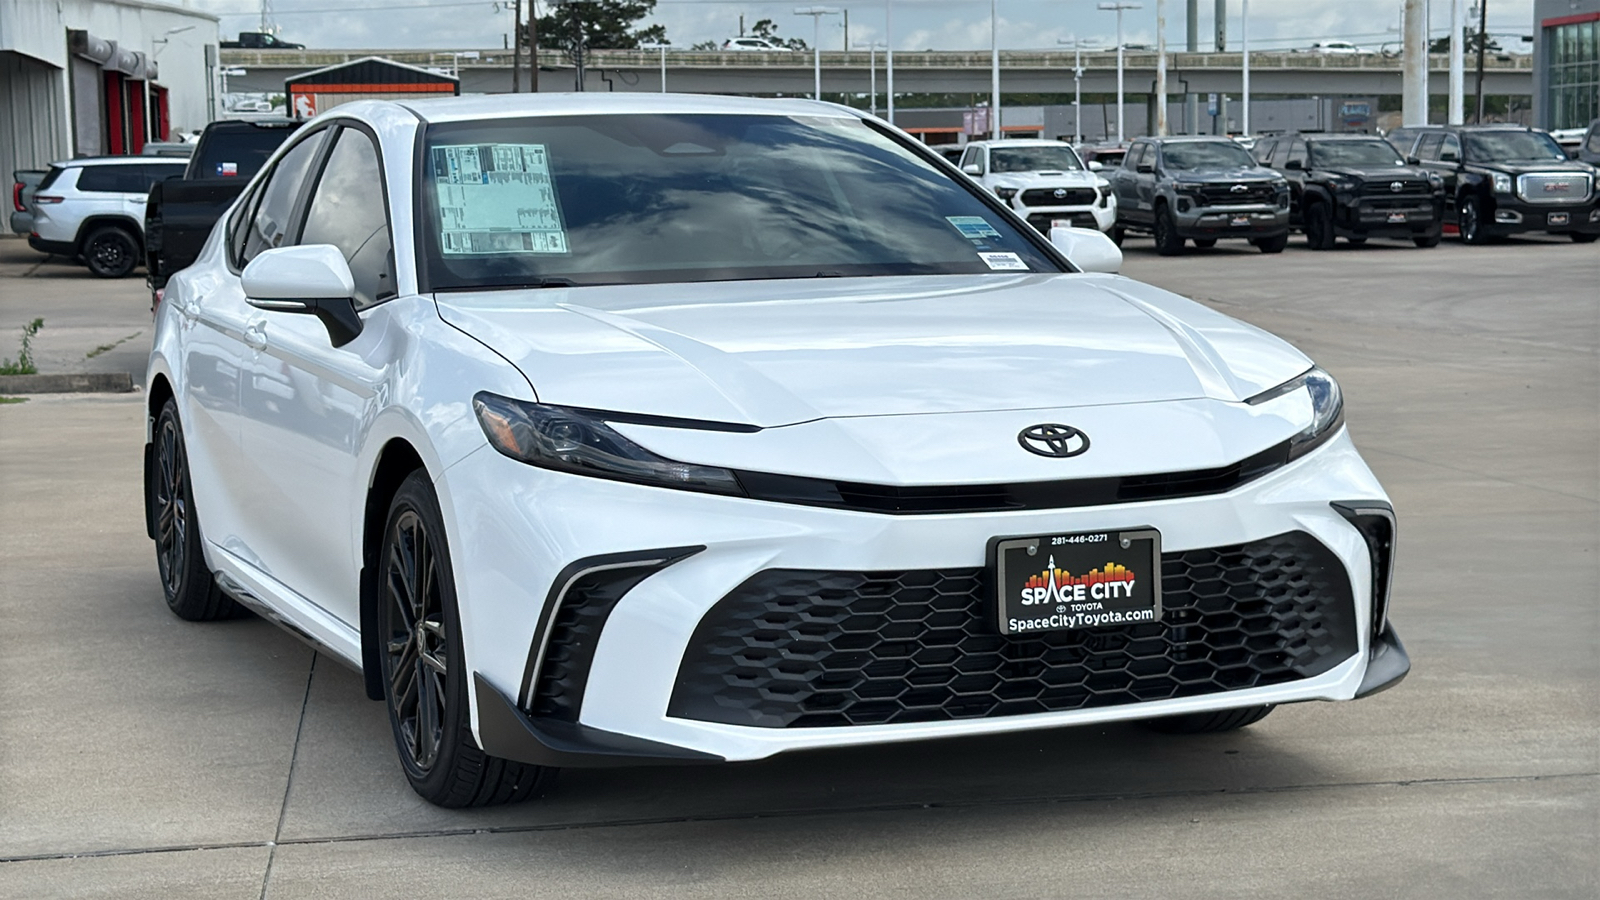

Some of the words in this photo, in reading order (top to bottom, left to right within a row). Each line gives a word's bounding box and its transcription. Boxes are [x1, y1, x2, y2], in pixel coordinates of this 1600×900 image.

[1051, 534, 1108, 545] 281-446-0271
[1090, 580, 1135, 599] CITY
[1070, 602, 1103, 611] TOYOTA
[1009, 609, 1154, 632] SpaceCityToyota.com
